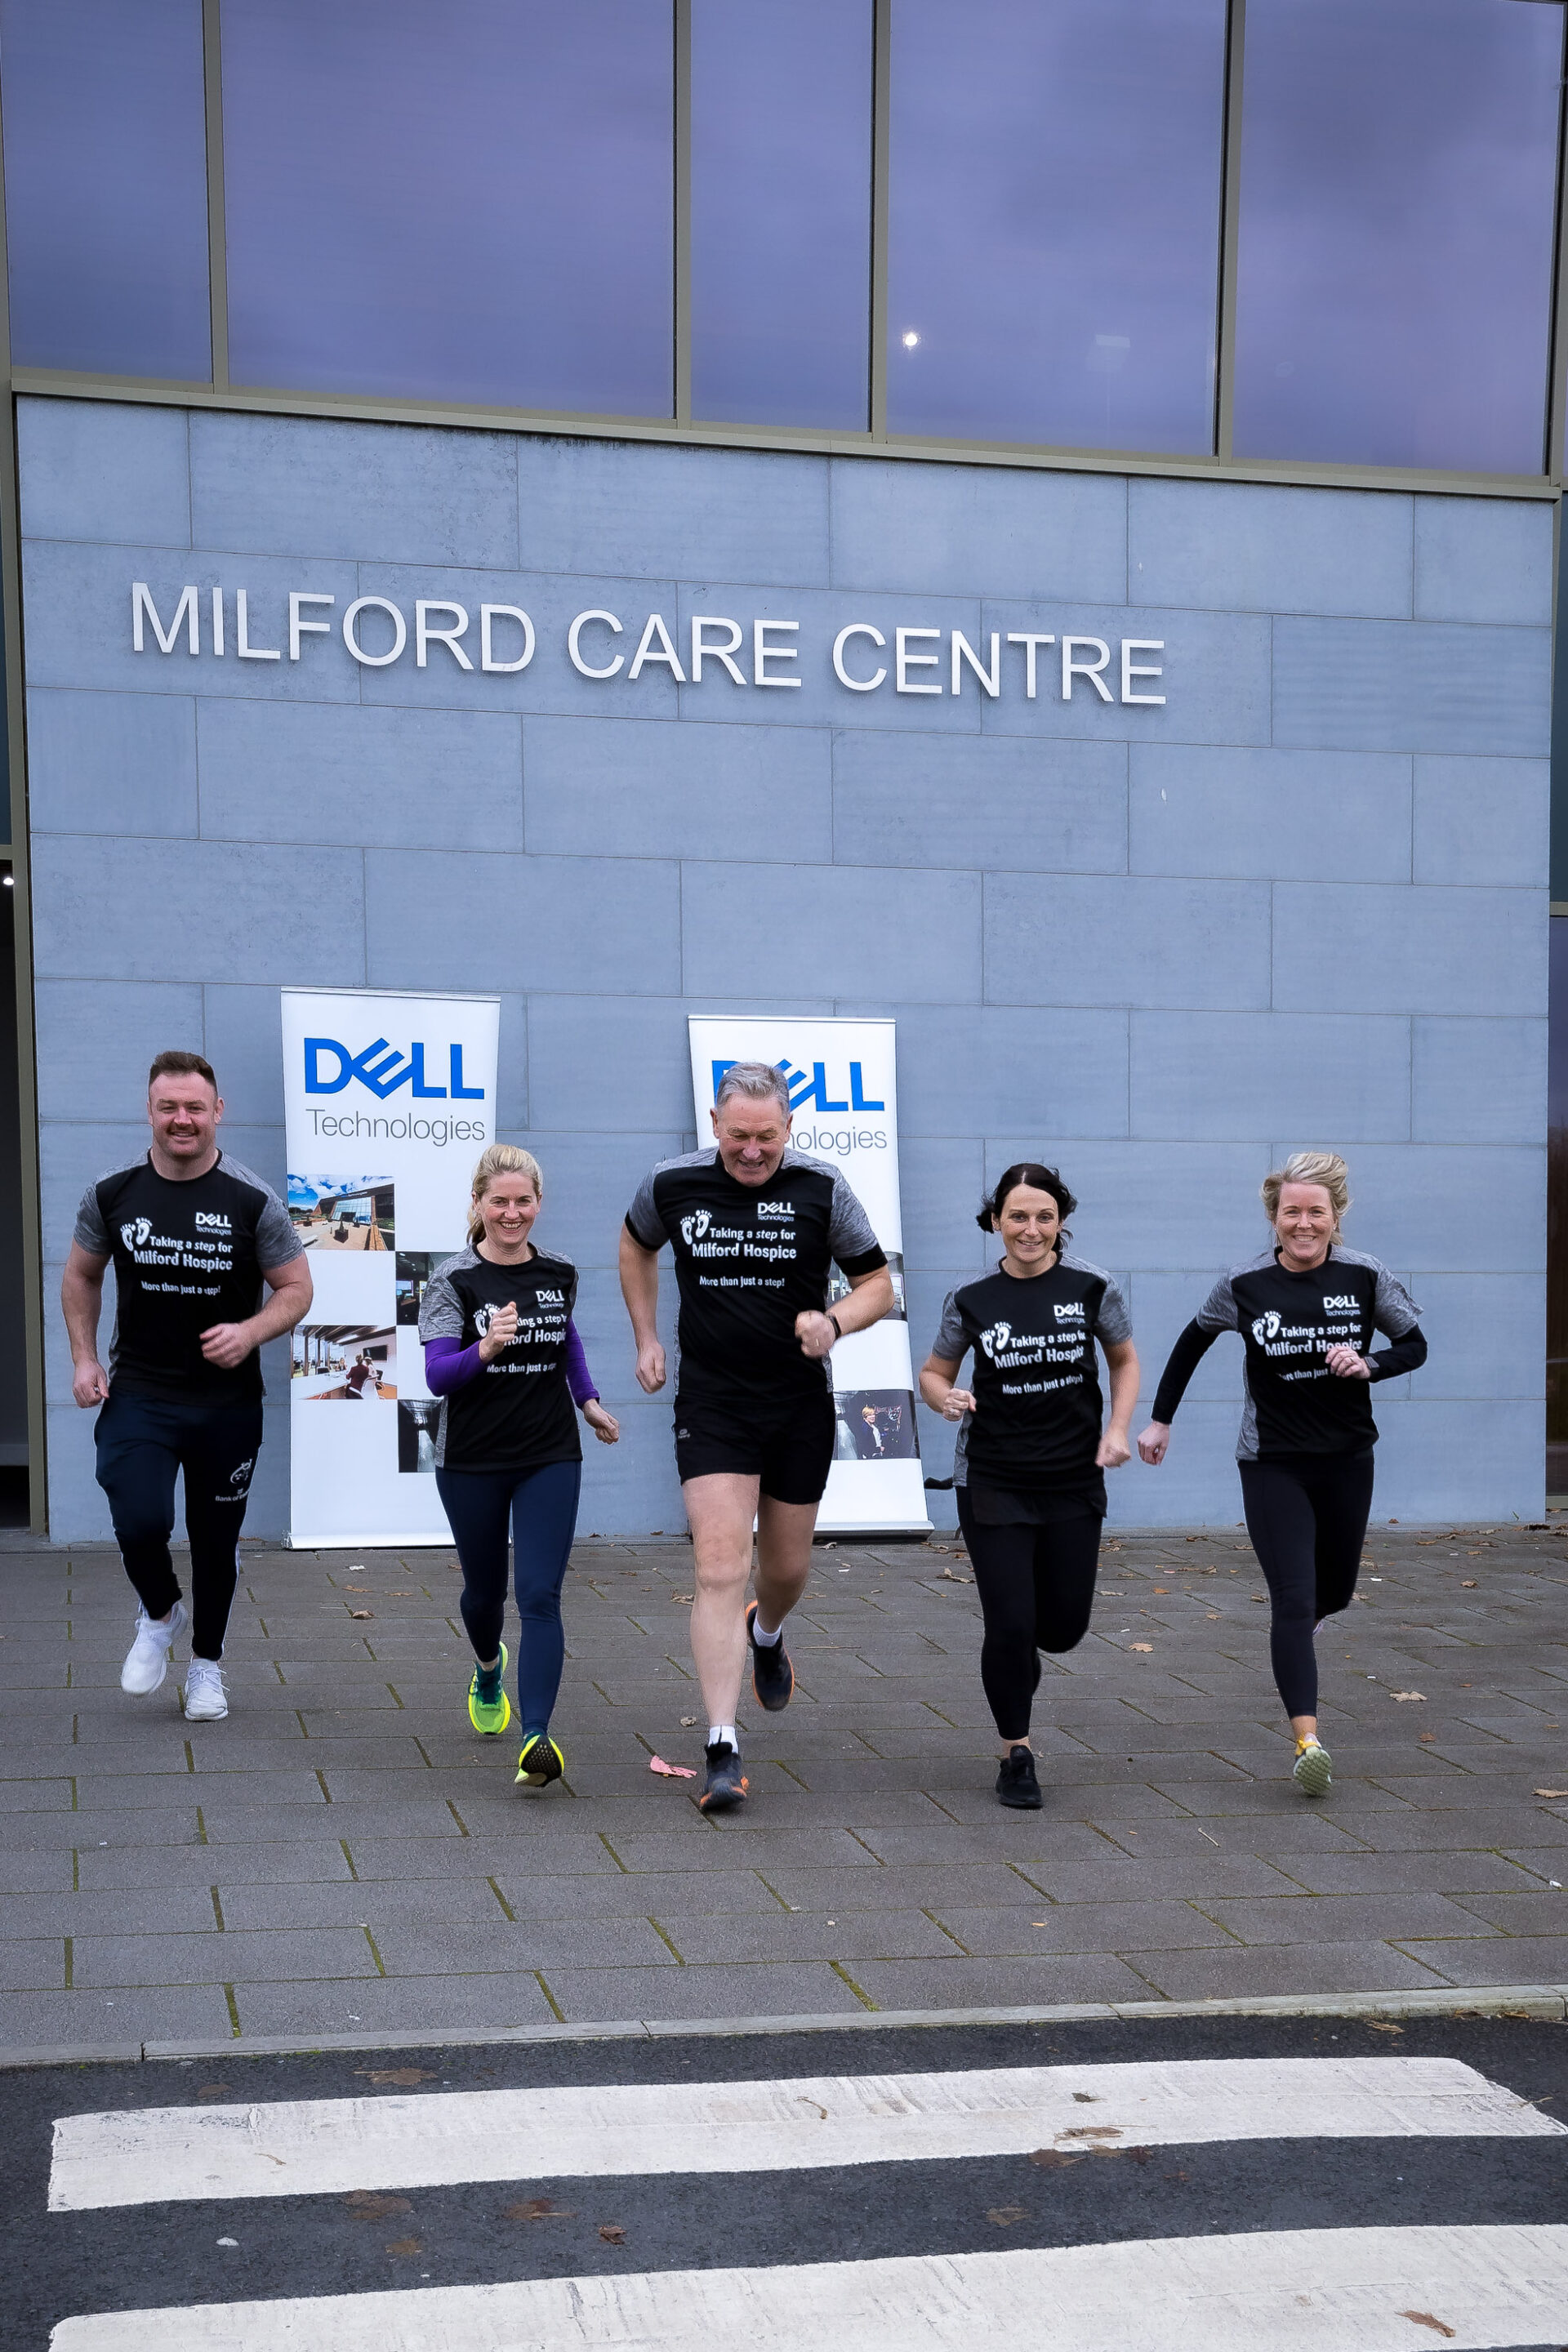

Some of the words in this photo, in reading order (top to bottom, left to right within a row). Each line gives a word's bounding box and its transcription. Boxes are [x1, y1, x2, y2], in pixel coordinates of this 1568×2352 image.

[132, 581, 536, 672] MILFORD
[568, 609, 802, 688] CARE
[832, 623, 1166, 705] CENTRE
[304, 1037, 485, 1100] DELL
[305, 1108, 486, 1147] Technologies
[757, 1202, 795, 1214] DELL
[195, 1212, 232, 1227] DELL
[757, 1214, 795, 1223] Technologies
[710, 1227, 744, 1241] Taking
[746, 1231, 753, 1239] a
[755, 1230, 777, 1241] step
[780, 1229, 796, 1241] for
[149, 1236, 184, 1251] Taking
[185, 1241, 193, 1250] a
[194, 1241, 216, 1253] step
[218, 1241, 234, 1253] for
[692, 1242, 739, 1258] Milford
[744, 1244, 797, 1263] Hospice
[134, 1250, 179, 1266] Milford
[183, 1254, 233, 1273] Hospice
[140, 1281, 161, 1291] More
[162, 1282, 179, 1292] than
[180, 1285, 196, 1295] just
[699, 1275, 719, 1286] More
[720, 1276, 739, 1286] than
[741, 1276, 756, 1288] just
[764, 1277, 785, 1289] step!
[536, 1290, 564, 1302] DELL
[1323, 1294, 1360, 1309] DELL
[1054, 1303, 1085, 1316] DELL
[545, 1315, 562, 1325] step
[1280, 1326, 1316, 1339] Taking
[1317, 1327, 1325, 1335] a
[1325, 1325, 1348, 1336] step
[1349, 1322, 1362, 1333] for
[1010, 1335, 1046, 1348] Taking
[1047, 1334, 1055, 1343] a
[1057, 1333, 1077, 1343] step
[1264, 1340, 1312, 1356] Milford
[994, 1349, 1042, 1369] Milford
[487, 1365, 506, 1373] More
[509, 1362, 525, 1373] than
[526, 1363, 541, 1374] just
[1294, 1370, 1312, 1379] than
[1314, 1368, 1328, 1379] just
[1002, 1383, 1022, 1395] More
[1023, 1382, 1042, 1393] than
[1043, 1379, 1058, 1393] just
